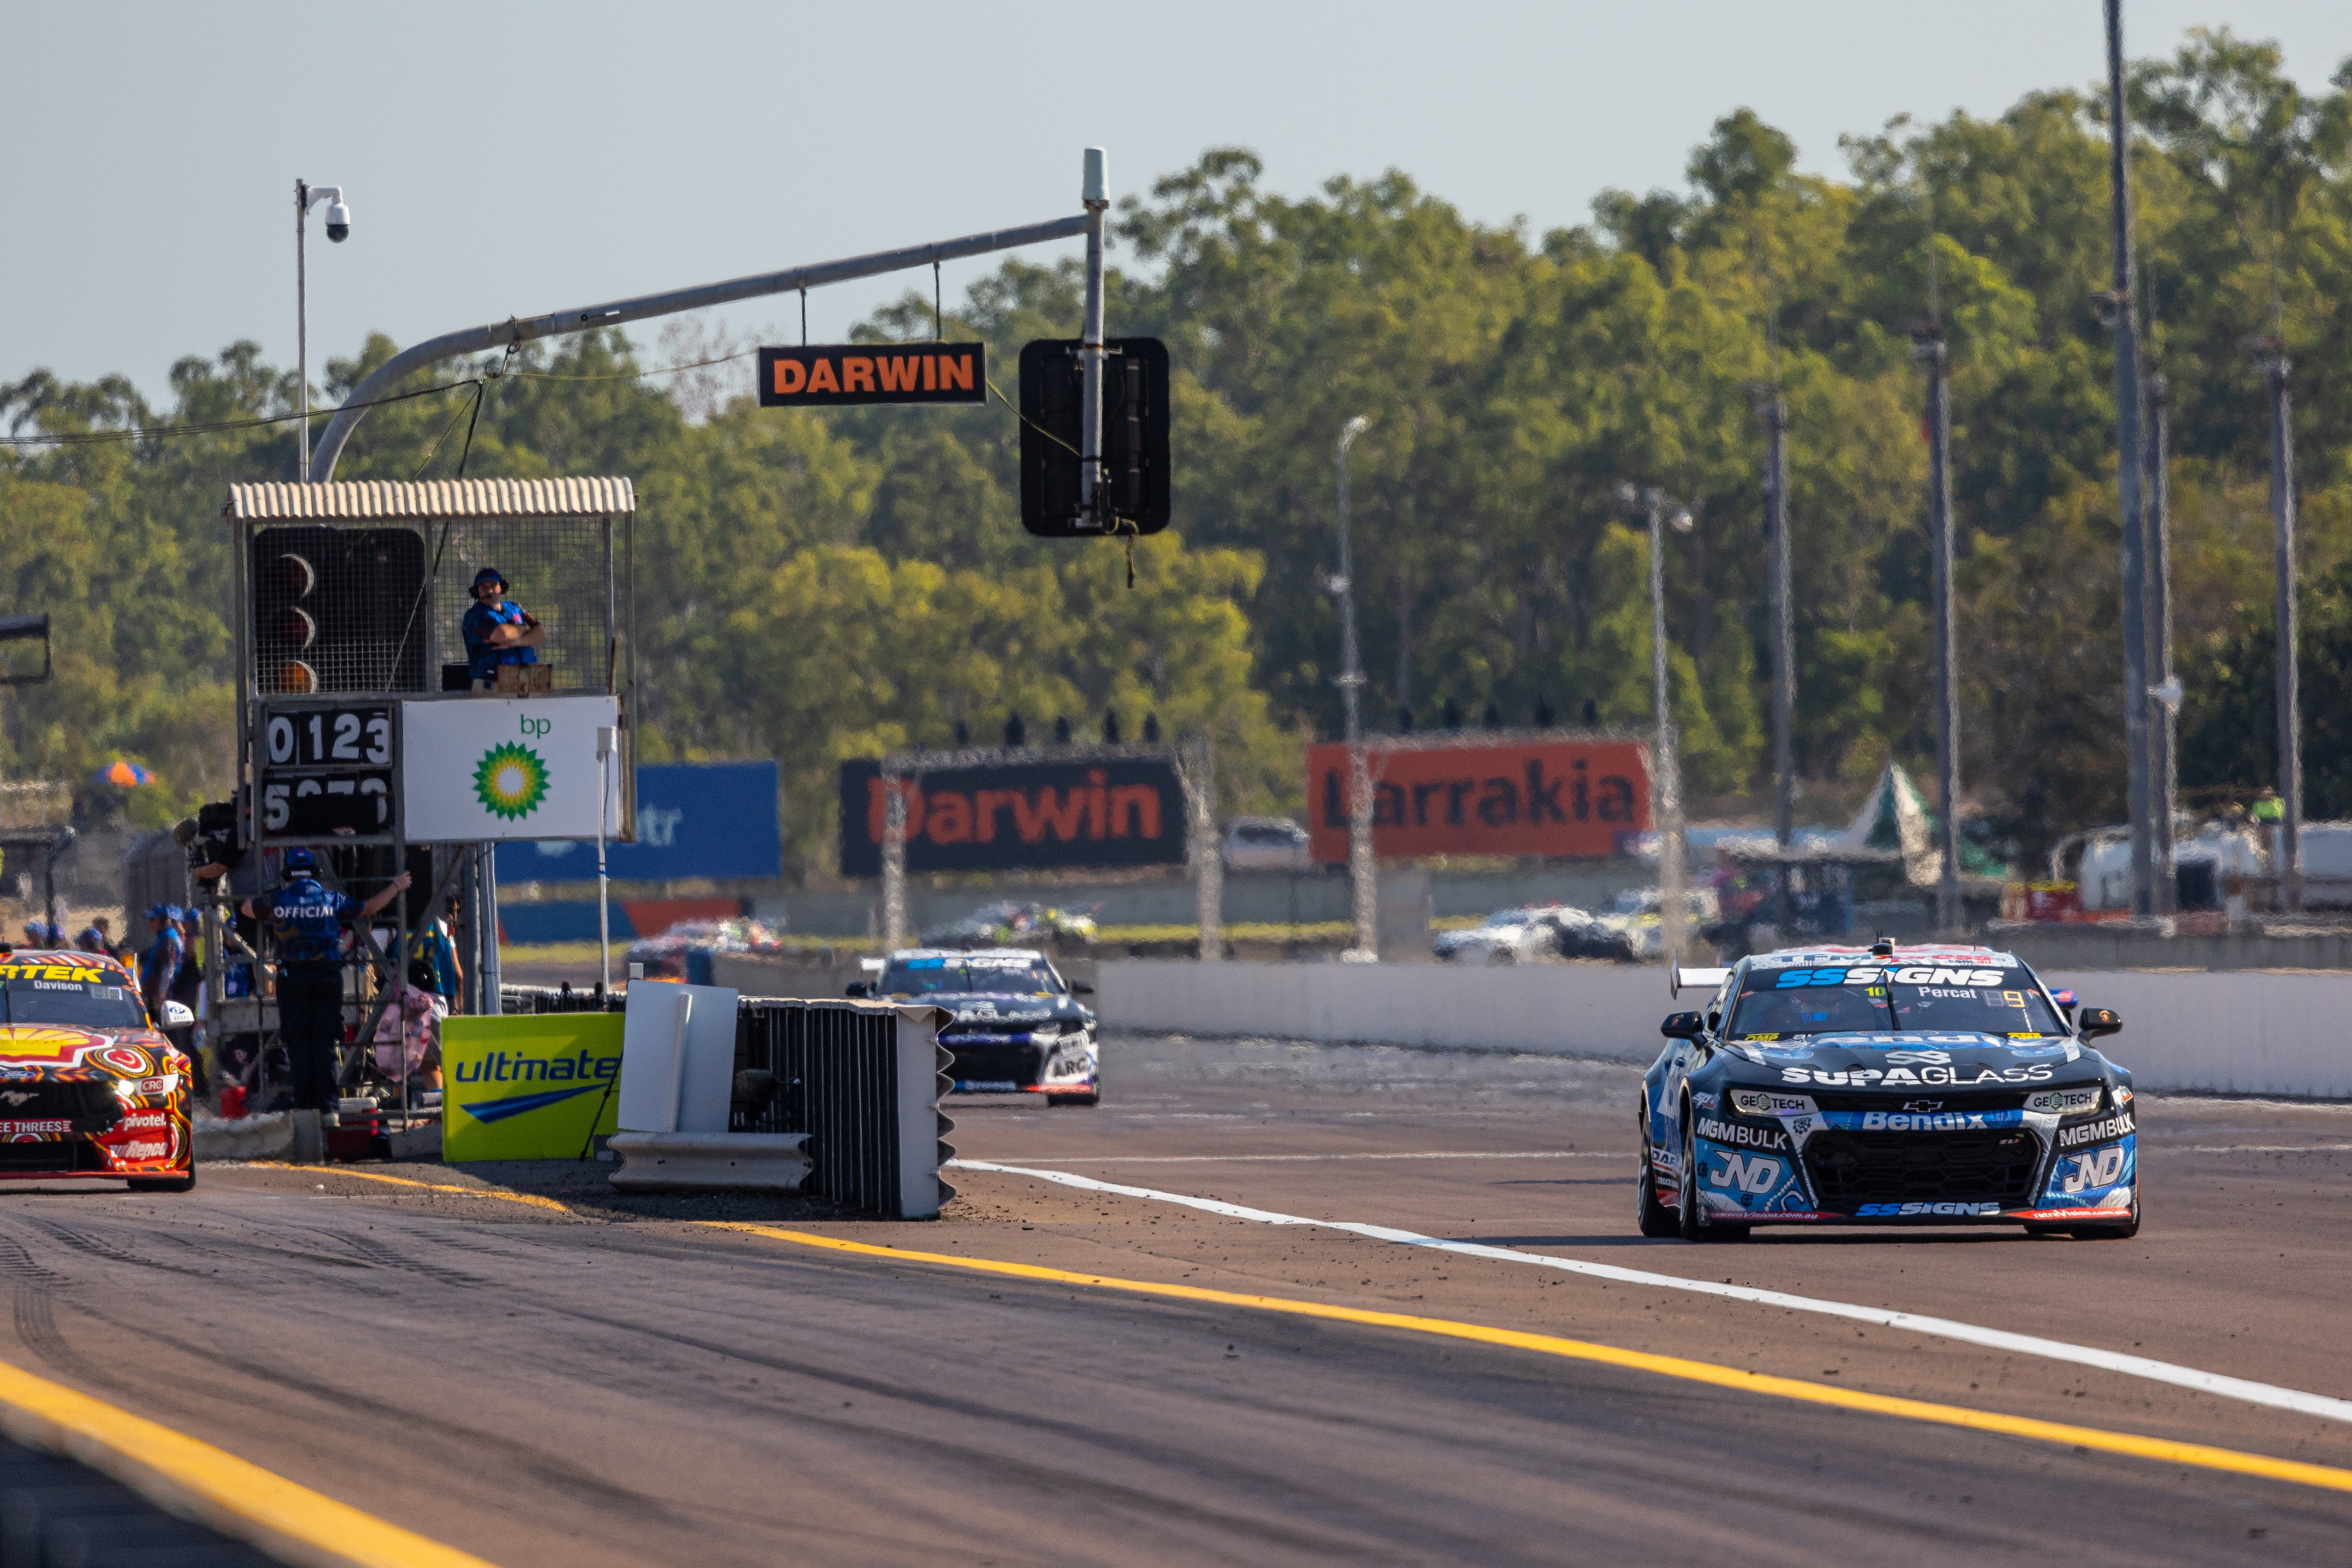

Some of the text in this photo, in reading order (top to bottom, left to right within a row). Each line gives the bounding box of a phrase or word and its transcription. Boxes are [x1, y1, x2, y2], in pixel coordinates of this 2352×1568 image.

[774, 354, 973, 394] DARWIN
[520, 713, 551, 739] bp
[868, 769, 1161, 845] Darwin
[274, 906, 335, 918] OFFICIAL
[34, 980, 83, 991] Davison
[1865, 987, 1886, 996] 10
[1918, 986, 1977, 999] Percat
[456, 1049, 622, 1082] ultimate
[1781, 1063, 2053, 1086] SUPAGLASS
[142, 1080, 162, 1091] CRC
[13, 1121, 62, 1132] THREES
[1863, 1112, 1987, 1131] Bendix
[125, 1140, 169, 1160] Repco
